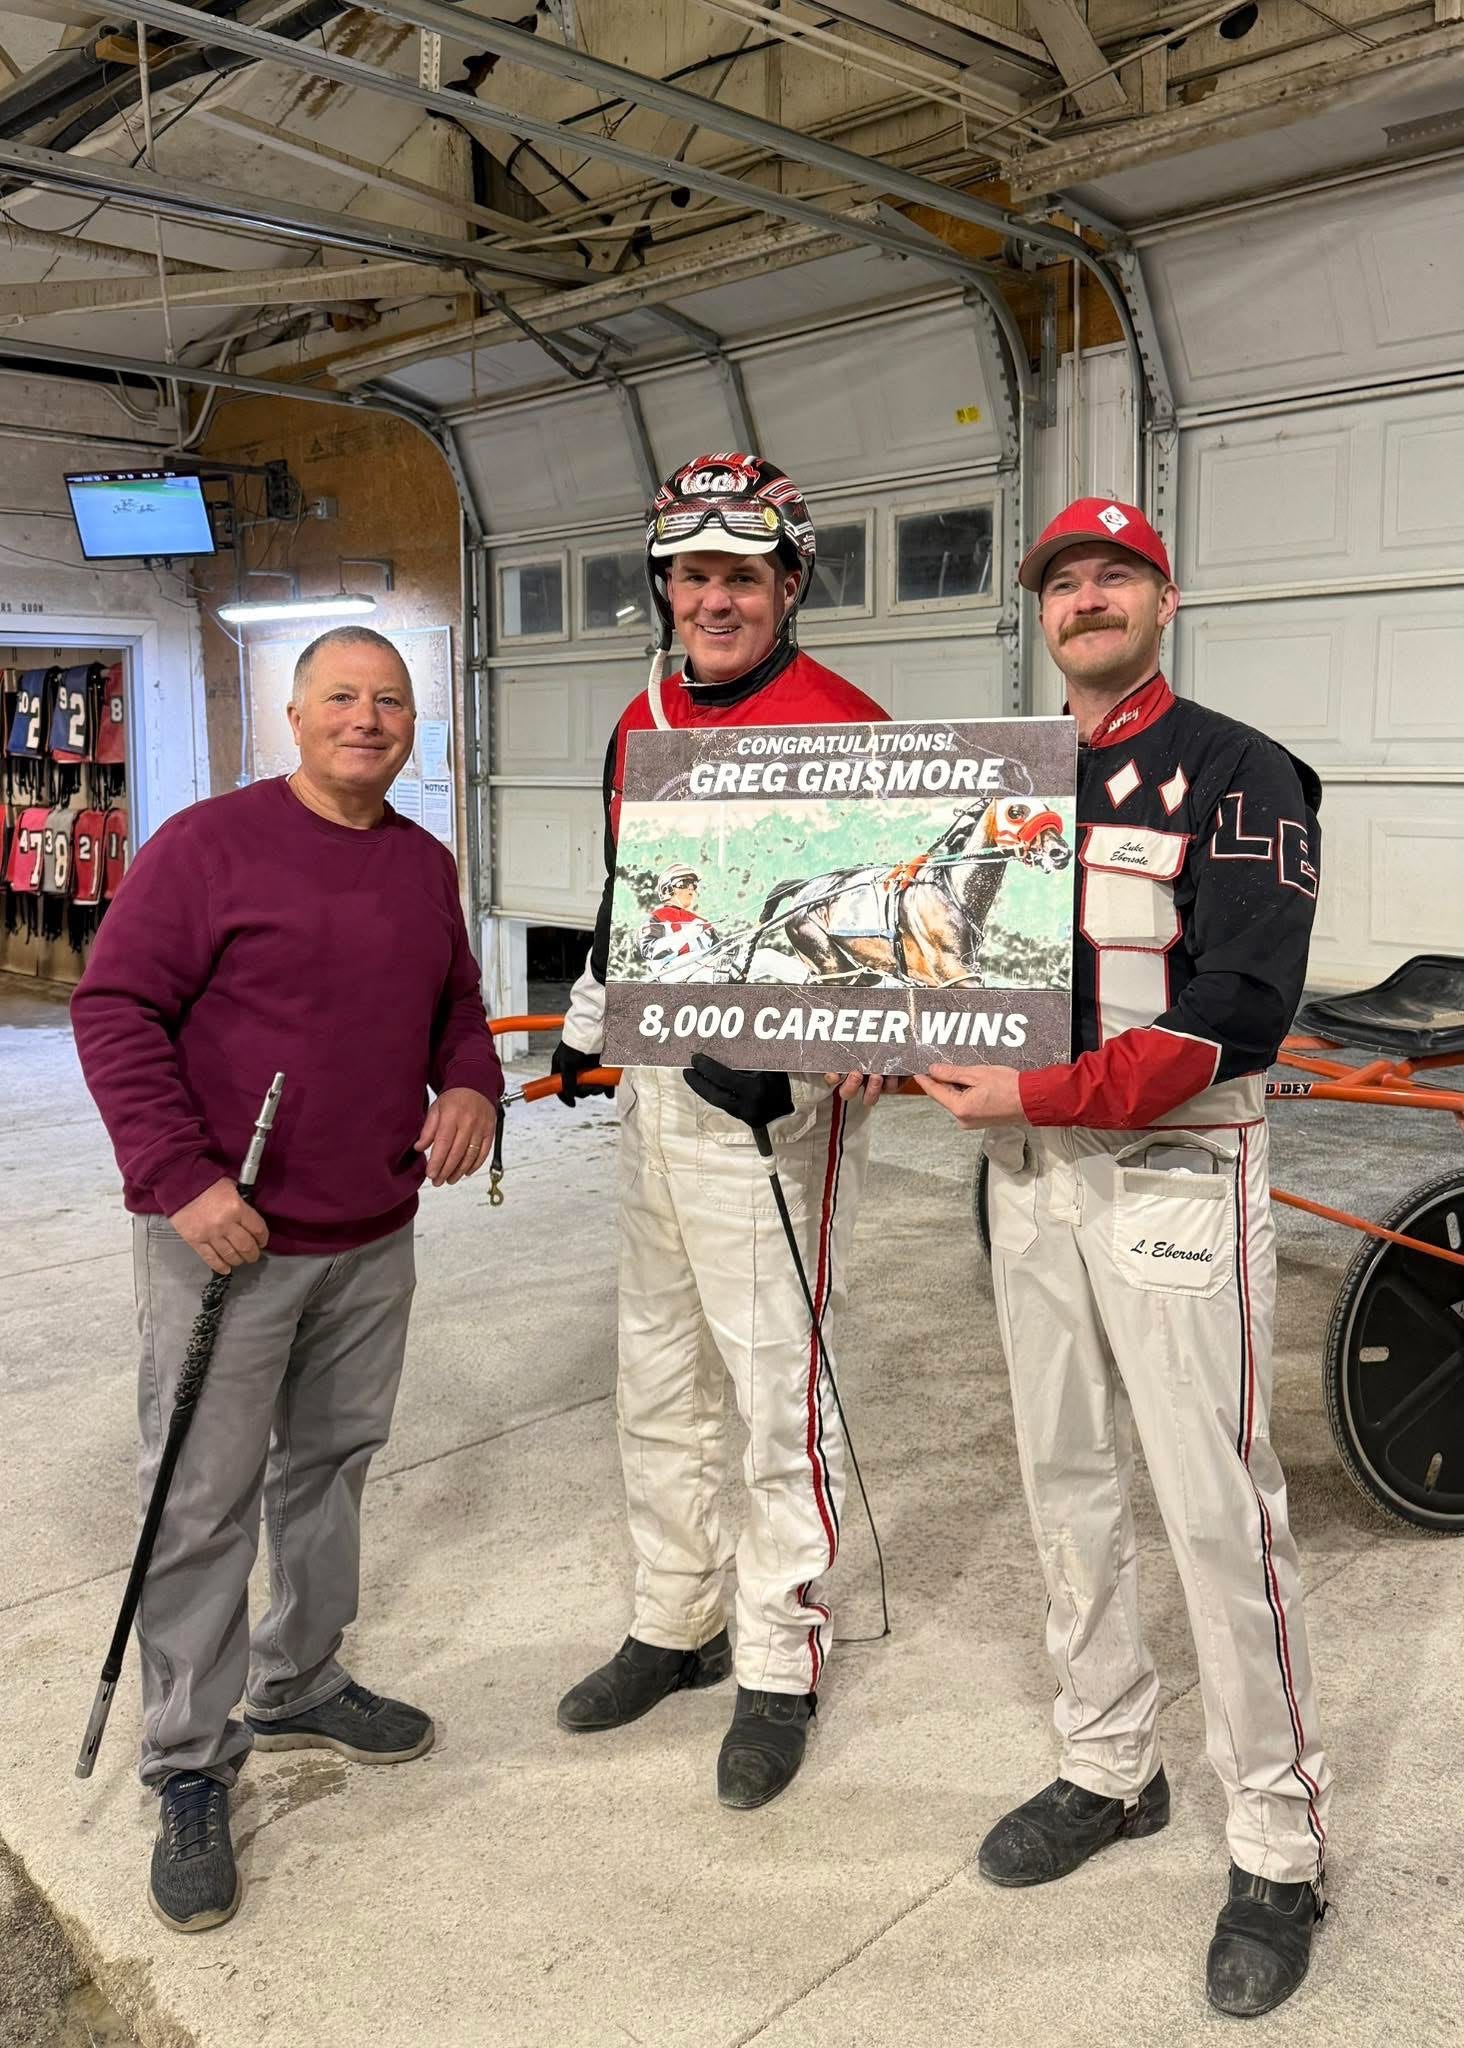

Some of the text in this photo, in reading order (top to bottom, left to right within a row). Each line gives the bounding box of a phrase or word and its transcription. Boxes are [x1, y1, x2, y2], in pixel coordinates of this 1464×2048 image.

[59, 686, 68, 710] 9
[111, 698, 123, 722] 8
[68, 692, 86, 748] 2
[737, 733, 954, 755] CONGRATULATIONS!
[689, 758, 1005, 793] GREG GRISMORE
[424, 783, 449, 793] NOTICE
[79, 836, 91, 860] 2
[1110, 851, 1149, 866] Ebersole
[1119, 841, 1144, 852] Luke
[639, 1004, 1029, 1048] 8,000 CAREER WINS
[1279, 1082, 1313, 1095] DEY
[1130, 1239, 1213, 1263] L. Ebersole
